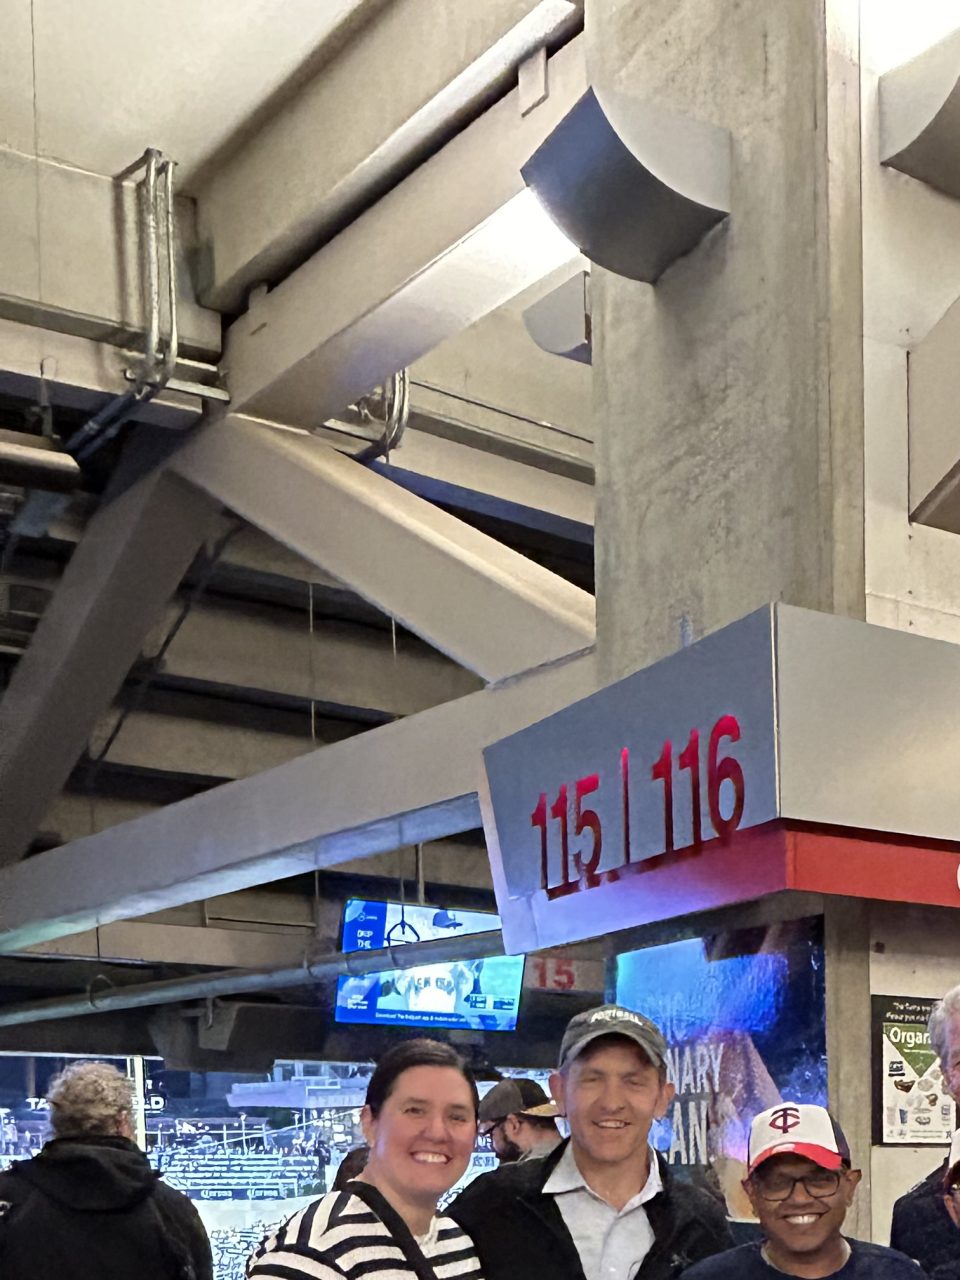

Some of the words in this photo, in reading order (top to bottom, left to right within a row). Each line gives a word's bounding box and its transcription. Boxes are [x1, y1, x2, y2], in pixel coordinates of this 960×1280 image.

[531, 773, 602, 889] 115
[652, 714, 745, 852] 116
[890, 1026, 932, 1047] Organ
[666, 1042, 724, 1094] NARY
